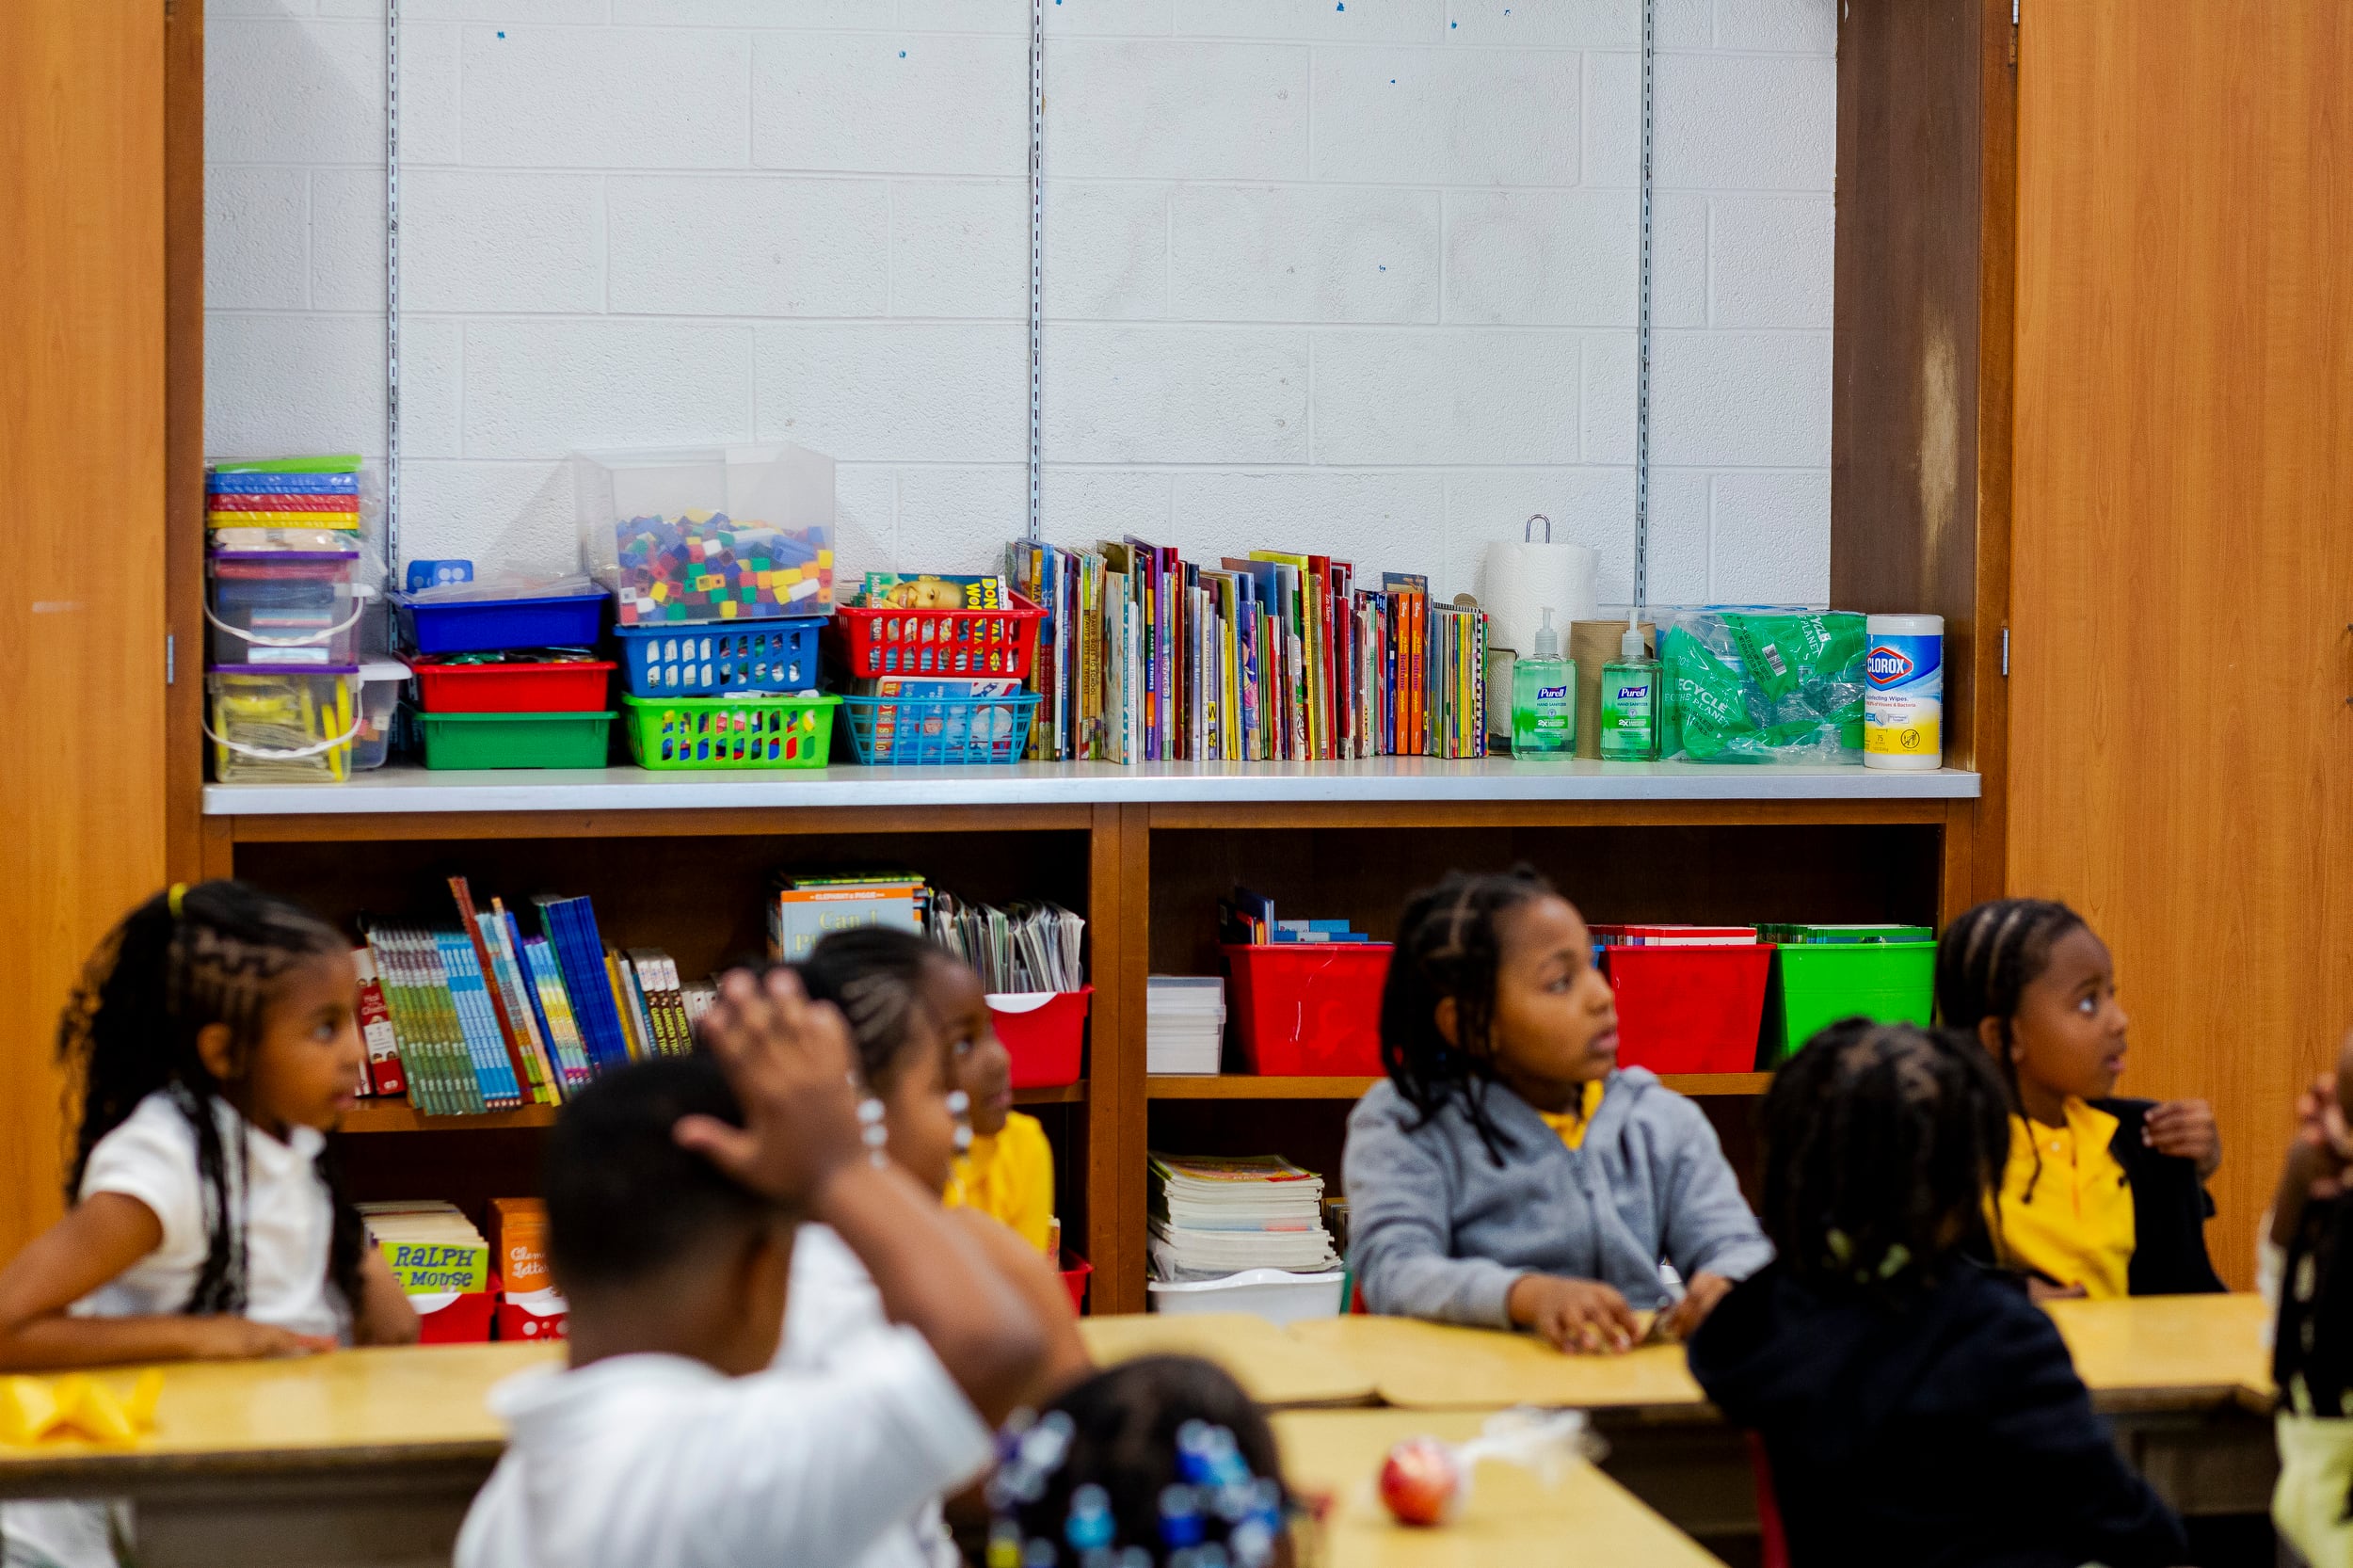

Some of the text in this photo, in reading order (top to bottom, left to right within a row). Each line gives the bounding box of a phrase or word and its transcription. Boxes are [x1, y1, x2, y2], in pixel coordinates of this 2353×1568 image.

[1090, 659, 1096, 667] TO
[1867, 658, 1904, 674] CLOROX
[1400, 654, 1408, 690] Bedtime
[1541, 688, 1564, 697] Purell
[1621, 688, 1645, 697] Purell
[1678, 679, 1728, 713] ECYCLE
[1692, 698, 1730, 728] PLANET
[819, 910, 860, 929] Can
